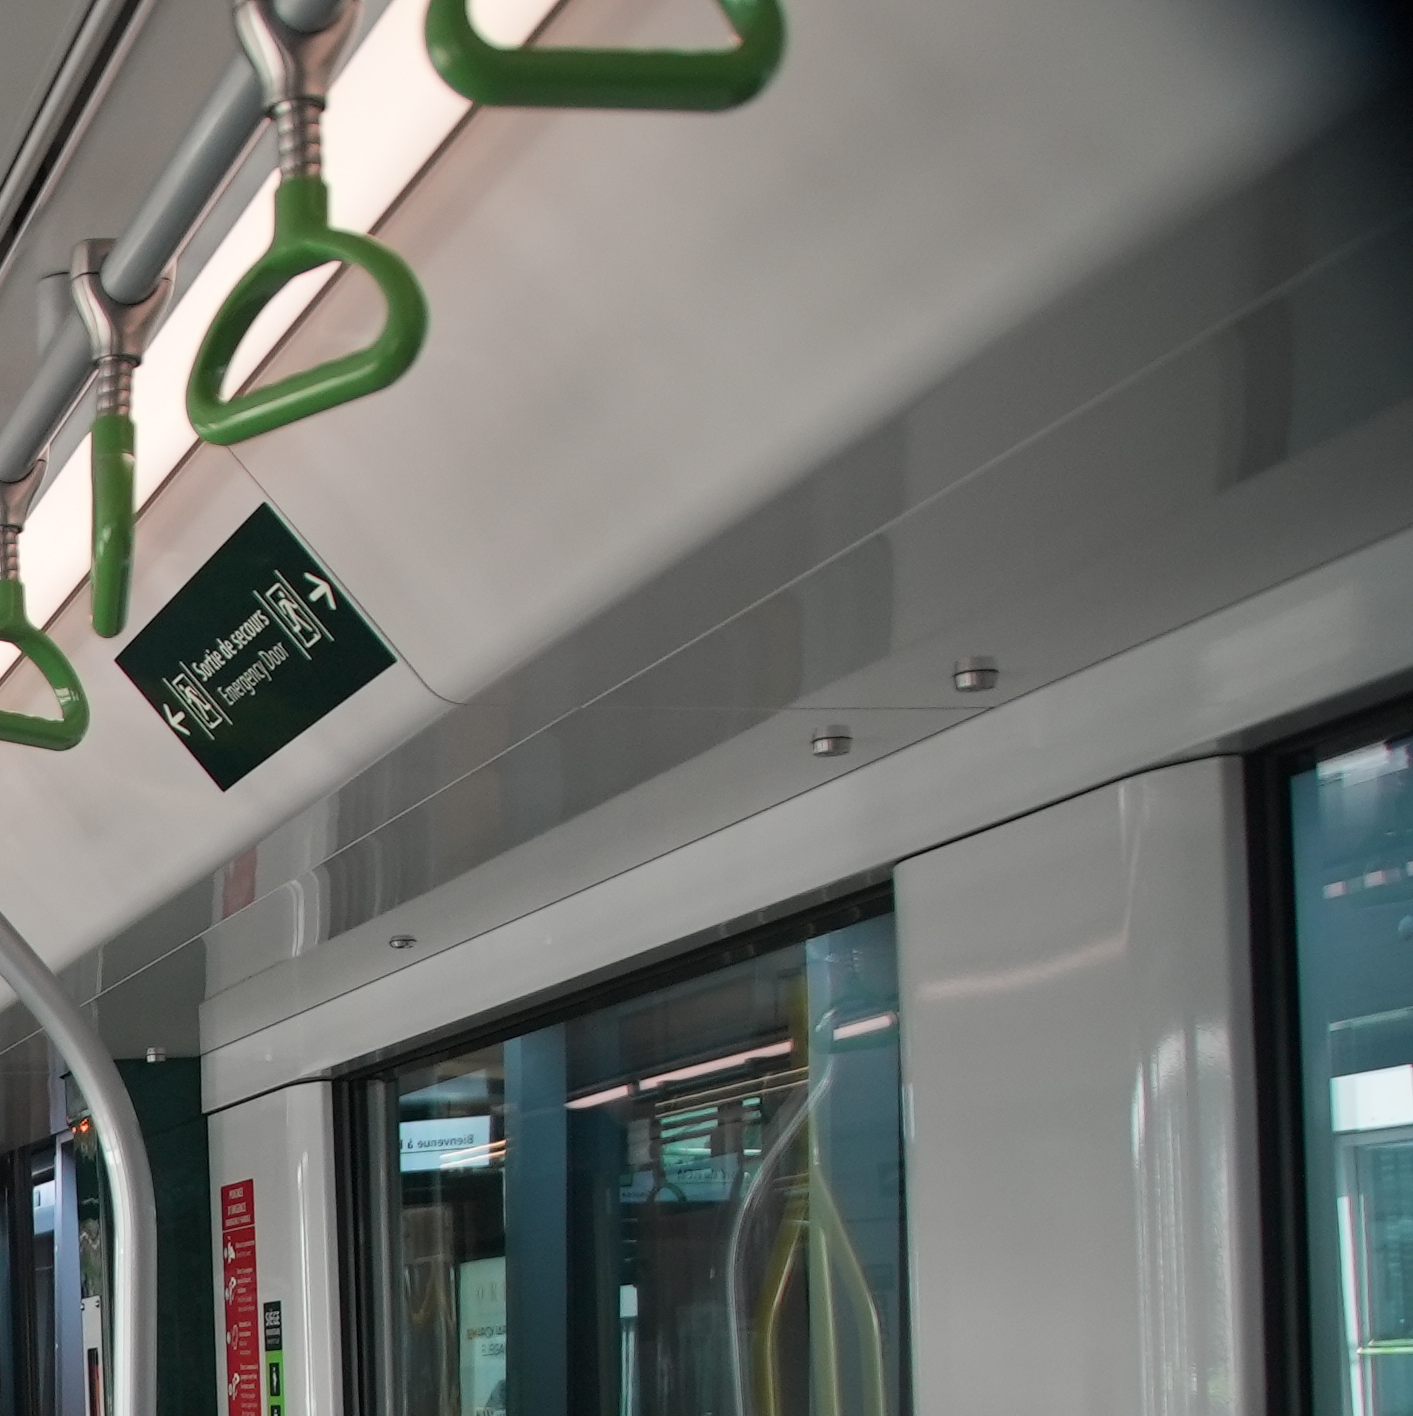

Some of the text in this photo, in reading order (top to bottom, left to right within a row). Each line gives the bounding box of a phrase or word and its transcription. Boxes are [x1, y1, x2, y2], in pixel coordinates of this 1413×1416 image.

[192, 609, 270, 682] Sortie de secours
[217, 642, 289, 706] Emergency Door
